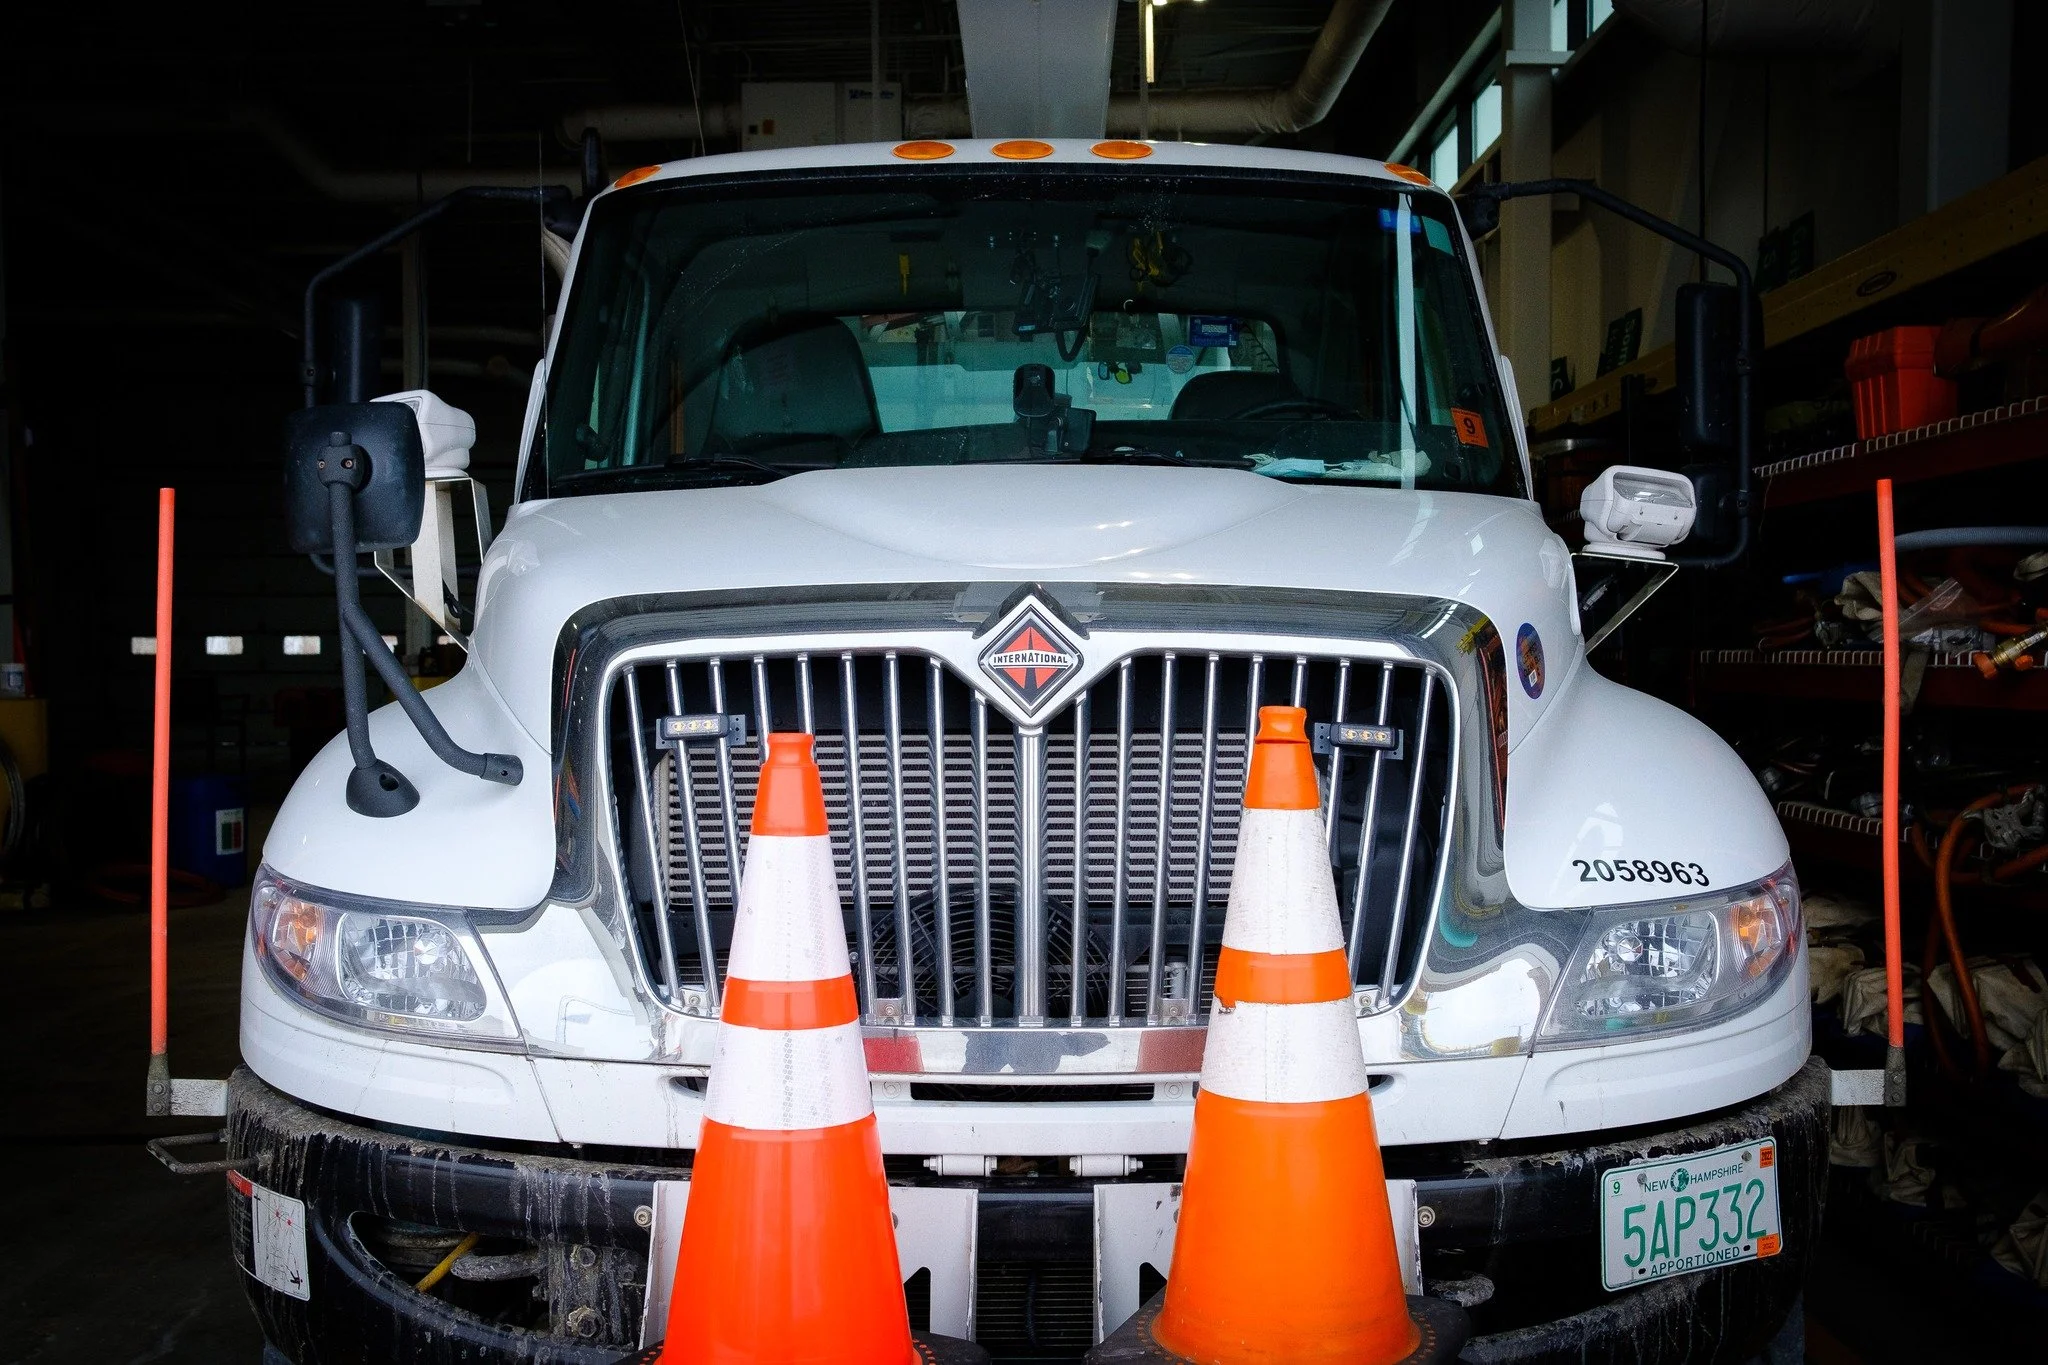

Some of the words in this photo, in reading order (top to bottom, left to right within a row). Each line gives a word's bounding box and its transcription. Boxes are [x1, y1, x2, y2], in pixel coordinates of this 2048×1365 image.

[1463, 417, 1476, 435] 9
[993, 652, 1068, 664] INTERNATIONAL
[1572, 859, 1710, 887] 2058963
[1613, 1181, 1621, 1194] 9
[1644, 1179, 1669, 1193] NEW
[1690, 1162, 1744, 1184] HAMPSHIRE
[1623, 1178, 1767, 1268] 5AP332
[1650, 1246, 1741, 1276] APPORTIONED
